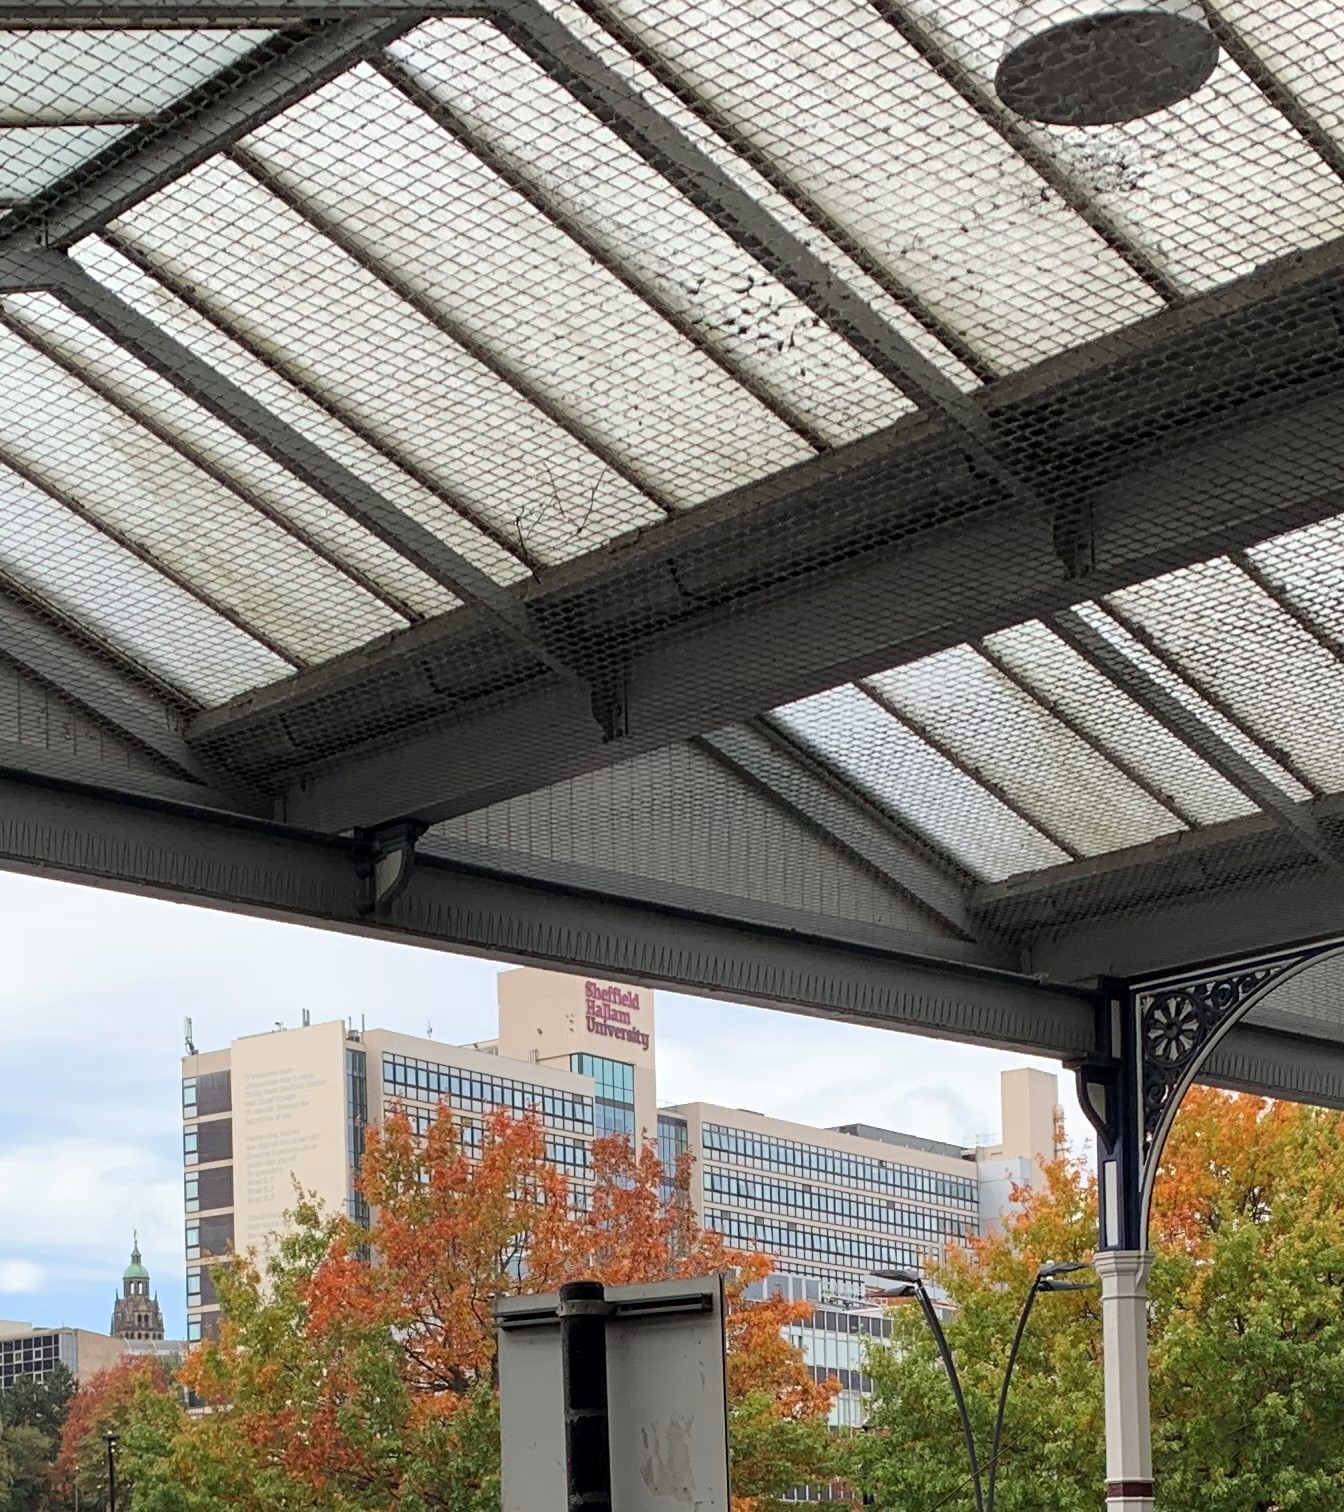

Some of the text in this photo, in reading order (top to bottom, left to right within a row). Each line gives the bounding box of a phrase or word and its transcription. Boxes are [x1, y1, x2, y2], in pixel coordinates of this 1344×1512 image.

[585, 980, 640, 1010] Sheffield
[585, 999, 631, 1025] Hallam
[585, 1015, 649, 1051] University
